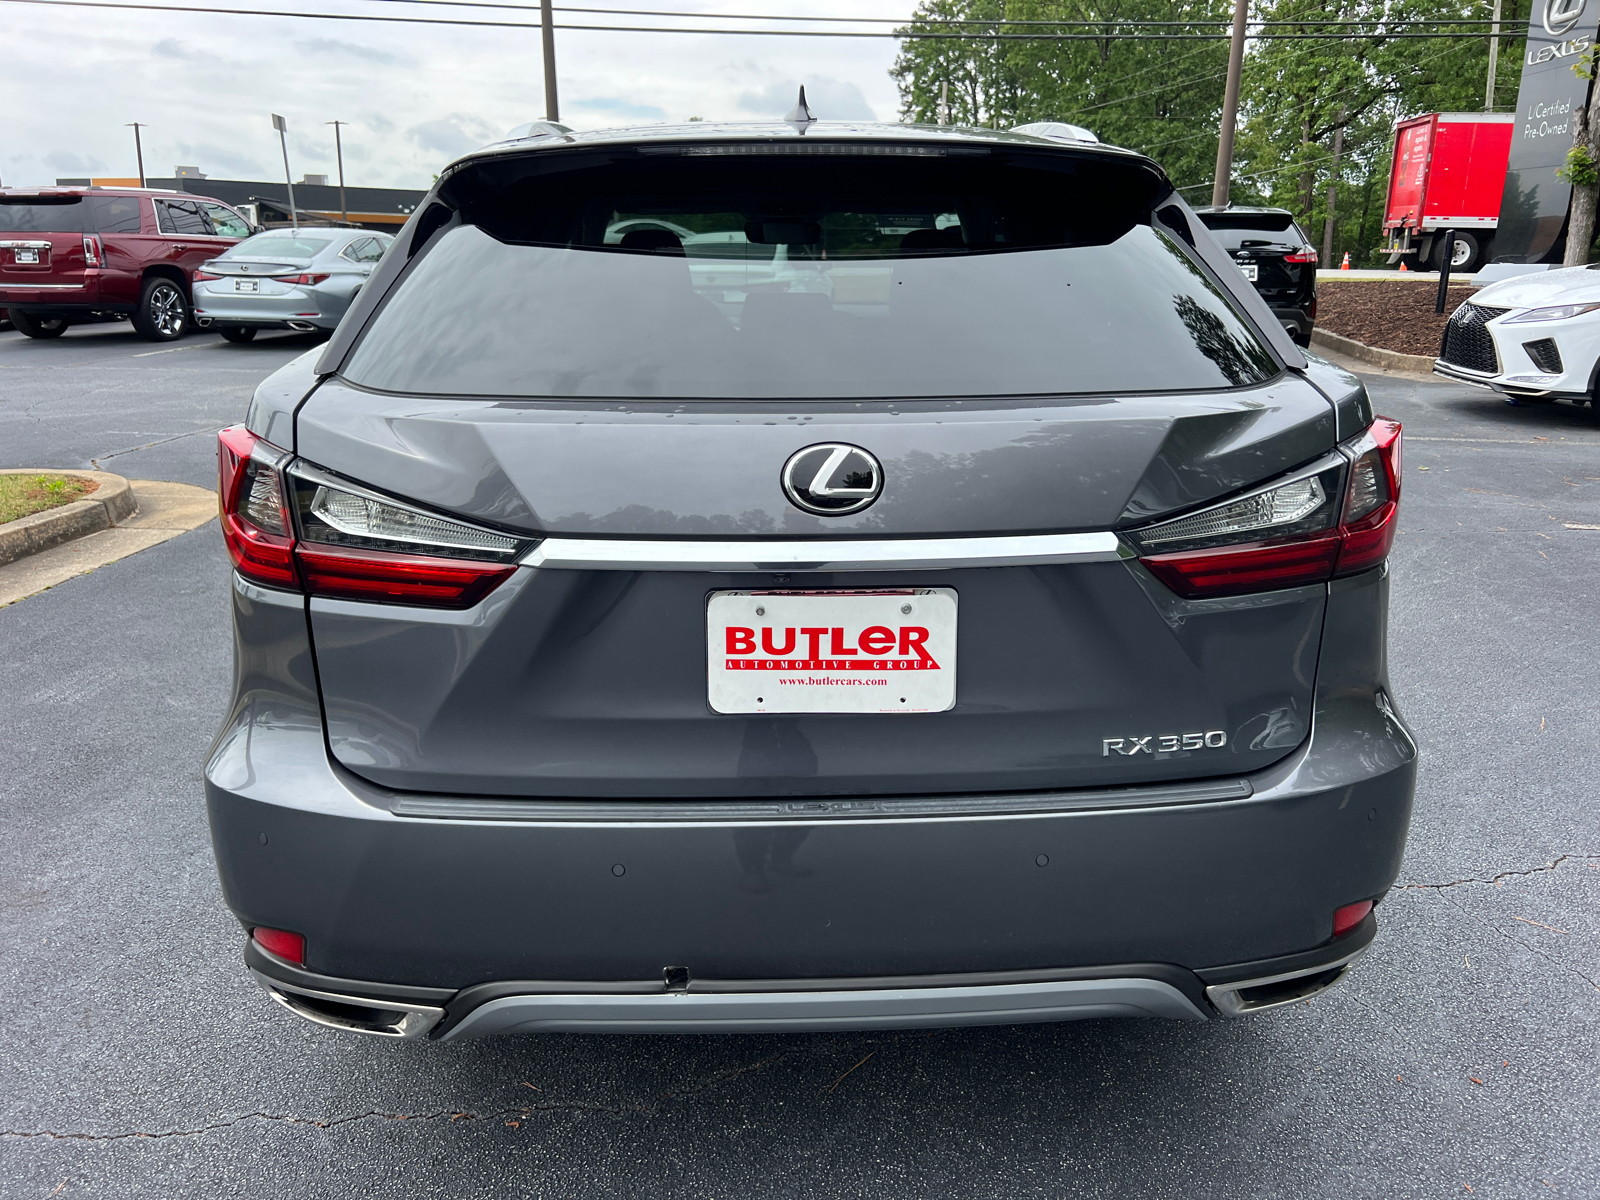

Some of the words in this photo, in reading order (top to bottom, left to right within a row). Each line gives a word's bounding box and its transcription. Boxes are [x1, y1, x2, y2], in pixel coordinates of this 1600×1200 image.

[1527, 35, 1590, 66] LEXUS
[1524, 118, 1568, 139] Pre-Owned
[727, 660, 852, 669] AUTOMOTIVE
[873, 660, 934, 669] GROUP
[779, 676, 888, 686] www.butlercars.com
[1102, 736, 1153, 757] RX
[1158, 730, 1227, 753] 350
